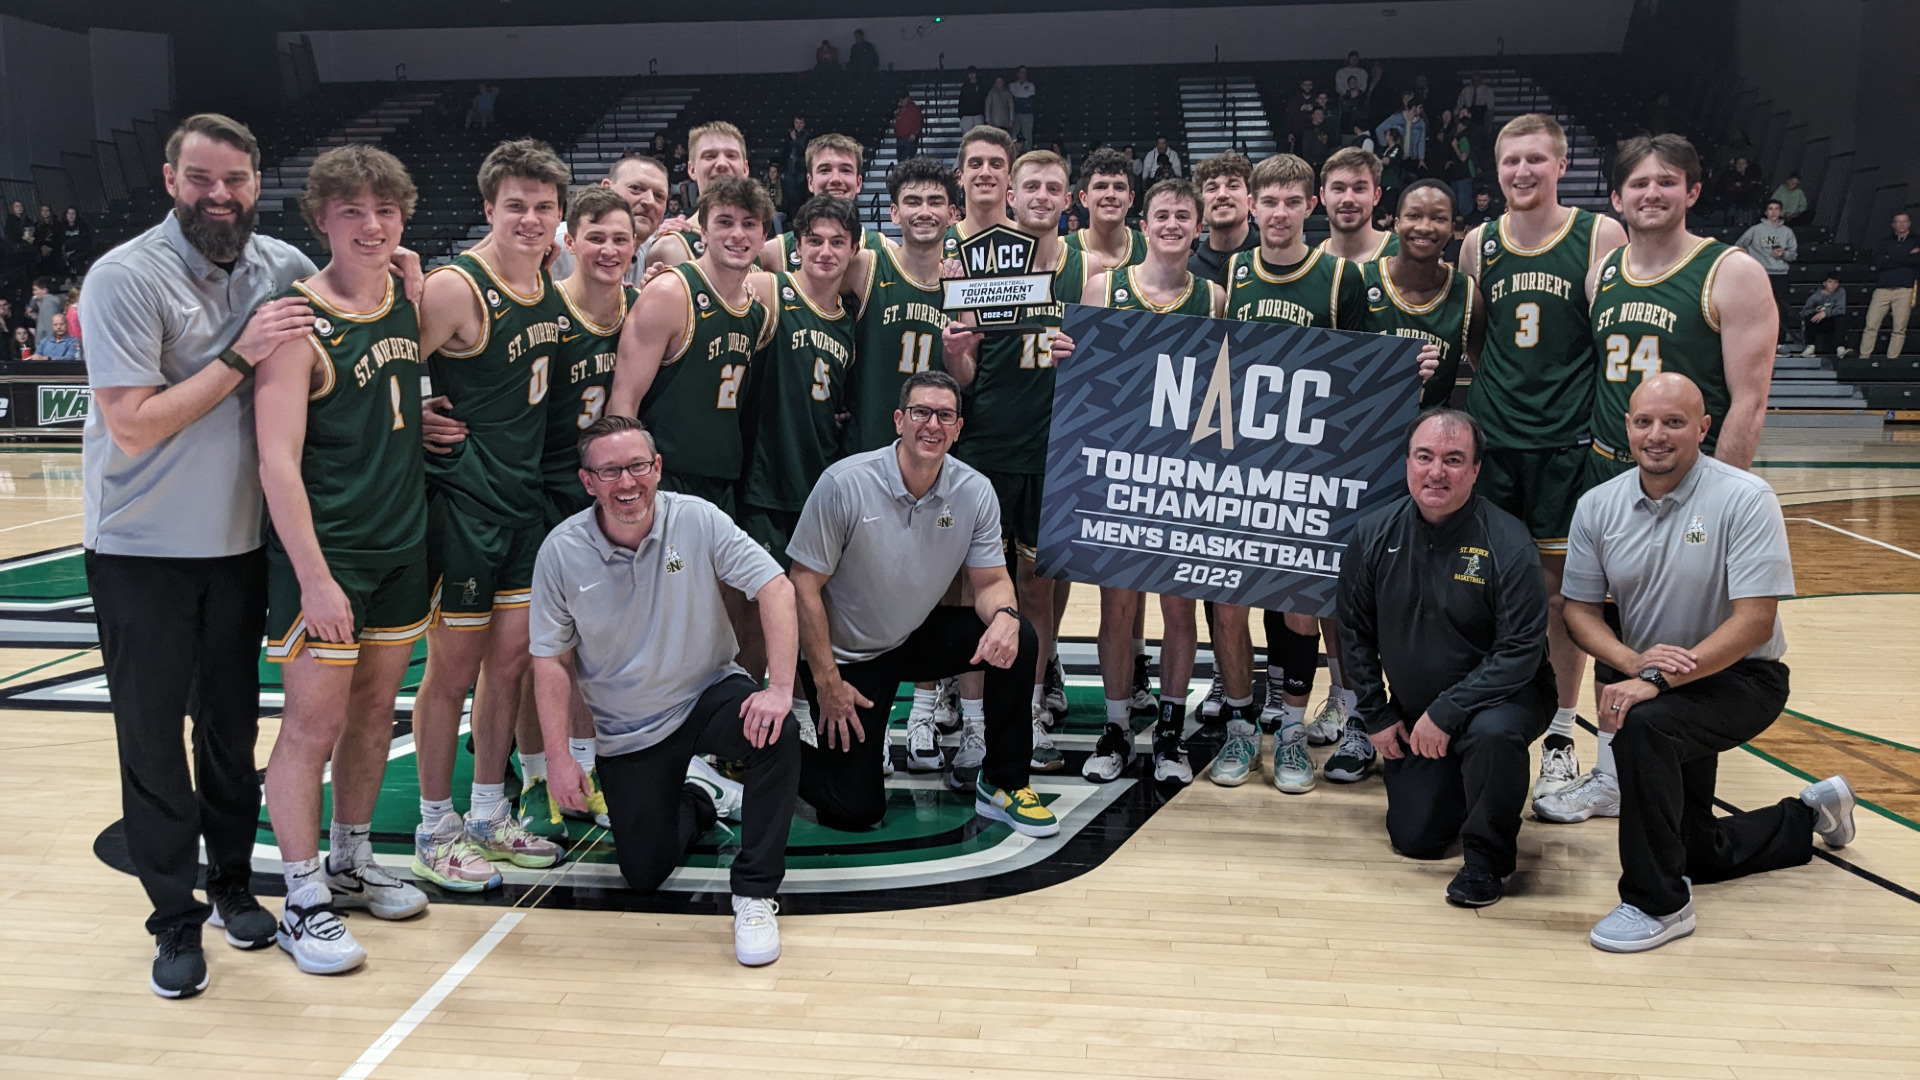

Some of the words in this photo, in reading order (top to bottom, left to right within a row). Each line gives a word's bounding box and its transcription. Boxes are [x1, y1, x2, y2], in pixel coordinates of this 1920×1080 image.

[971, 238, 1024, 274] NACC
[961, 284, 1034, 297] TOURNAMENT
[963, 293, 1027, 305] CHAMPIONS
[989, 279, 1026, 288] BASKETBALL
[1491, 278, 1508, 303] ST.
[1511, 271, 1572, 300] NORBERT
[883, 304, 901, 325] ST.
[905, 302, 952, 330] NORBER
[982, 310, 1013, 319] 2022-23
[1256, 298, 1314, 328] NORBERT
[1515, 302, 1541, 348] 3
[1597, 306, 1614, 332] ST.
[1618, 301, 1677, 333] NORBERT
[508, 334, 527, 363] ST.
[708, 336, 724, 361] ST.
[792, 328, 809, 350] ST.
[898, 330, 934, 374] 11
[1019, 326, 1061, 369] 15
[354, 354, 376, 388] ST.
[570, 359, 591, 384] ST.
[1605, 333, 1663, 382] 24
[528, 355, 550, 406] 0
[811, 357, 831, 402] 5
[1150, 332, 1331, 450] NACC
[390, 375, 405, 431] 1
[1082, 447, 1369, 510] TOURNAMENT
[936, 516, 954, 528] SNC
[1106, 483, 1330, 537] CHAMPIONS
[1081, 518, 1164, 549] MEN'S
[1169, 530, 1341, 573] BASKETBALL
[1686, 531, 1706, 544] SNC
[1173, 563, 1243, 589] 2023
[1453, 573, 1486, 585] BASKETBALL
